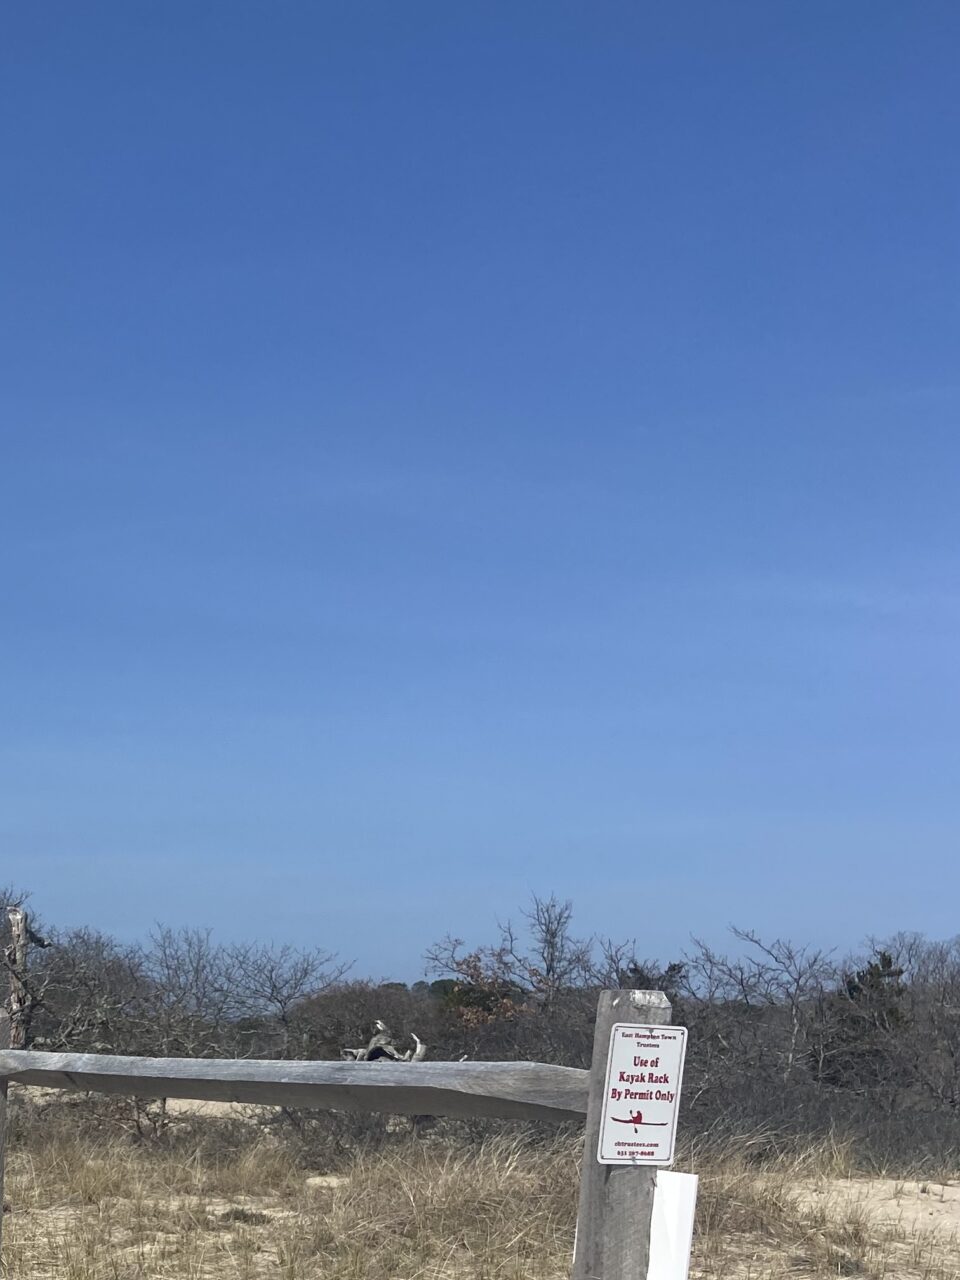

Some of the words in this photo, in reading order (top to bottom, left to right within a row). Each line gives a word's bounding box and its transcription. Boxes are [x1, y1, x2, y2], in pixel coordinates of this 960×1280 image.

[634, 1056, 648, 1067] Use
[650, 1058, 659, 1067] of
[619, 1072, 645, 1084] Kayak
[648, 1073, 669, 1084] Rack
[611, 1089, 622, 1101] By
[624, 1090, 653, 1100] Permit
[655, 1091, 675, 1103] Only
